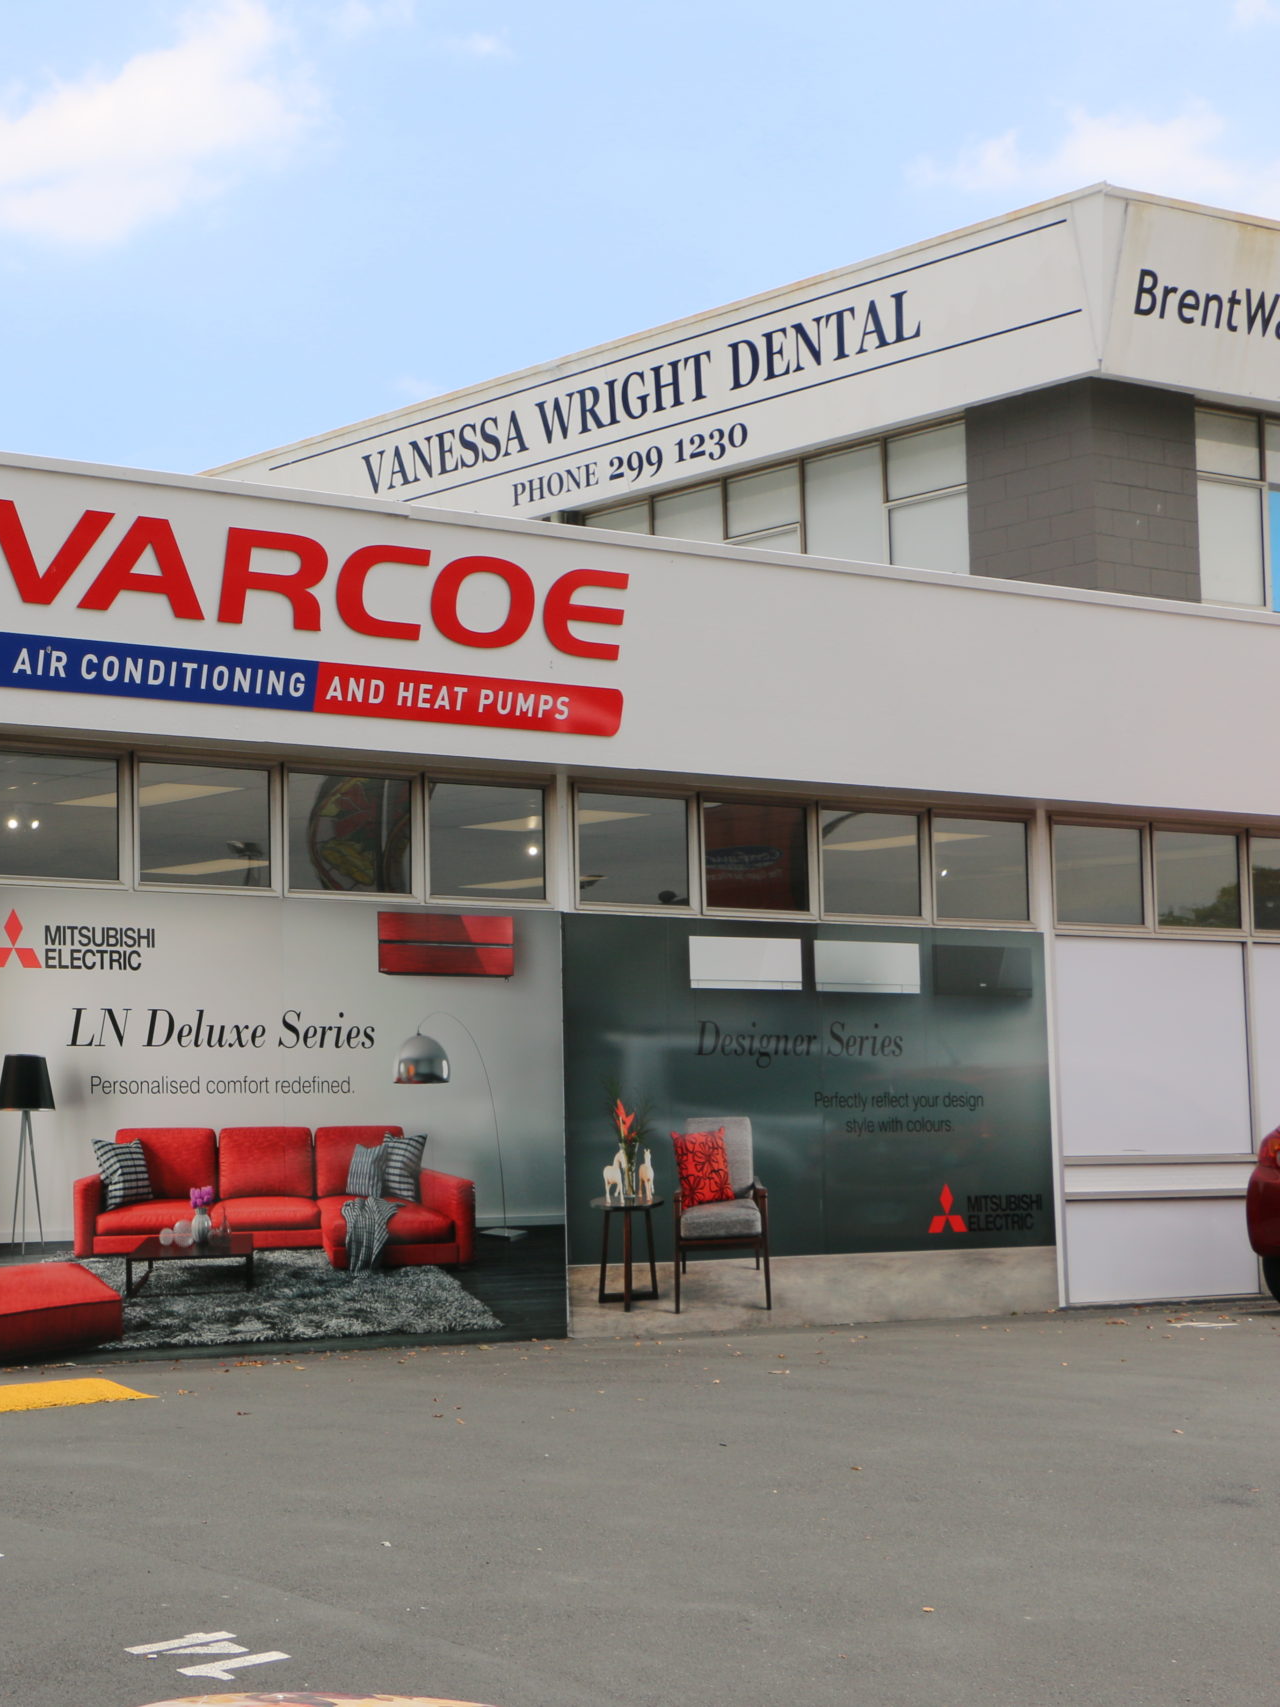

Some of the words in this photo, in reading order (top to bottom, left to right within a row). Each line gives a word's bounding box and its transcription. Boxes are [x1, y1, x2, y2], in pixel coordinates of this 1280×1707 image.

[1133, 267, 1280, 341] BrentW
[361, 416, 527, 495] VANESSA
[534, 350, 712, 445] WRIGHT
[728, 291, 922, 390] DENTAL
[512, 461, 599, 507] PHONE
[608, 447, 663, 482] 299
[674, 422, 748, 464] 1230
[12, 646, 67, 679] AIR
[80, 653, 307, 699] CONDITIONING
[325, 675, 385, 706] AND
[396, 682, 469, 712] HEAT
[478, 688, 570, 721] PUMPS
[43, 924, 156, 948] MITSUBISHI
[44, 949, 143, 972] ELECTRIC
[66, 1007, 131, 1048] LN
[142, 1008, 266, 1049] Deluxe
[277, 1010, 375, 1050] Series
[695, 1019, 817, 1069] Designer
[826, 1021, 904, 1058] Series
[90, 1074, 202, 1095] Personalised
[206, 1074, 270, 1095] comfort
[274, 1074, 355, 1095] redefined.
[814, 1091, 867, 1112] Perfectly
[871, 1091, 909, 1109] reflect
[912, 1094, 940, 1112] your
[942, 1091, 984, 1112] design
[845, 1117, 875, 1137] style
[878, 1116, 903, 1133] with
[906, 1116, 955, 1133] colours.
[966, 1194, 1043, 1214] MITSUBISHI
[967, 1214, 1035, 1231] ELECTRIC
